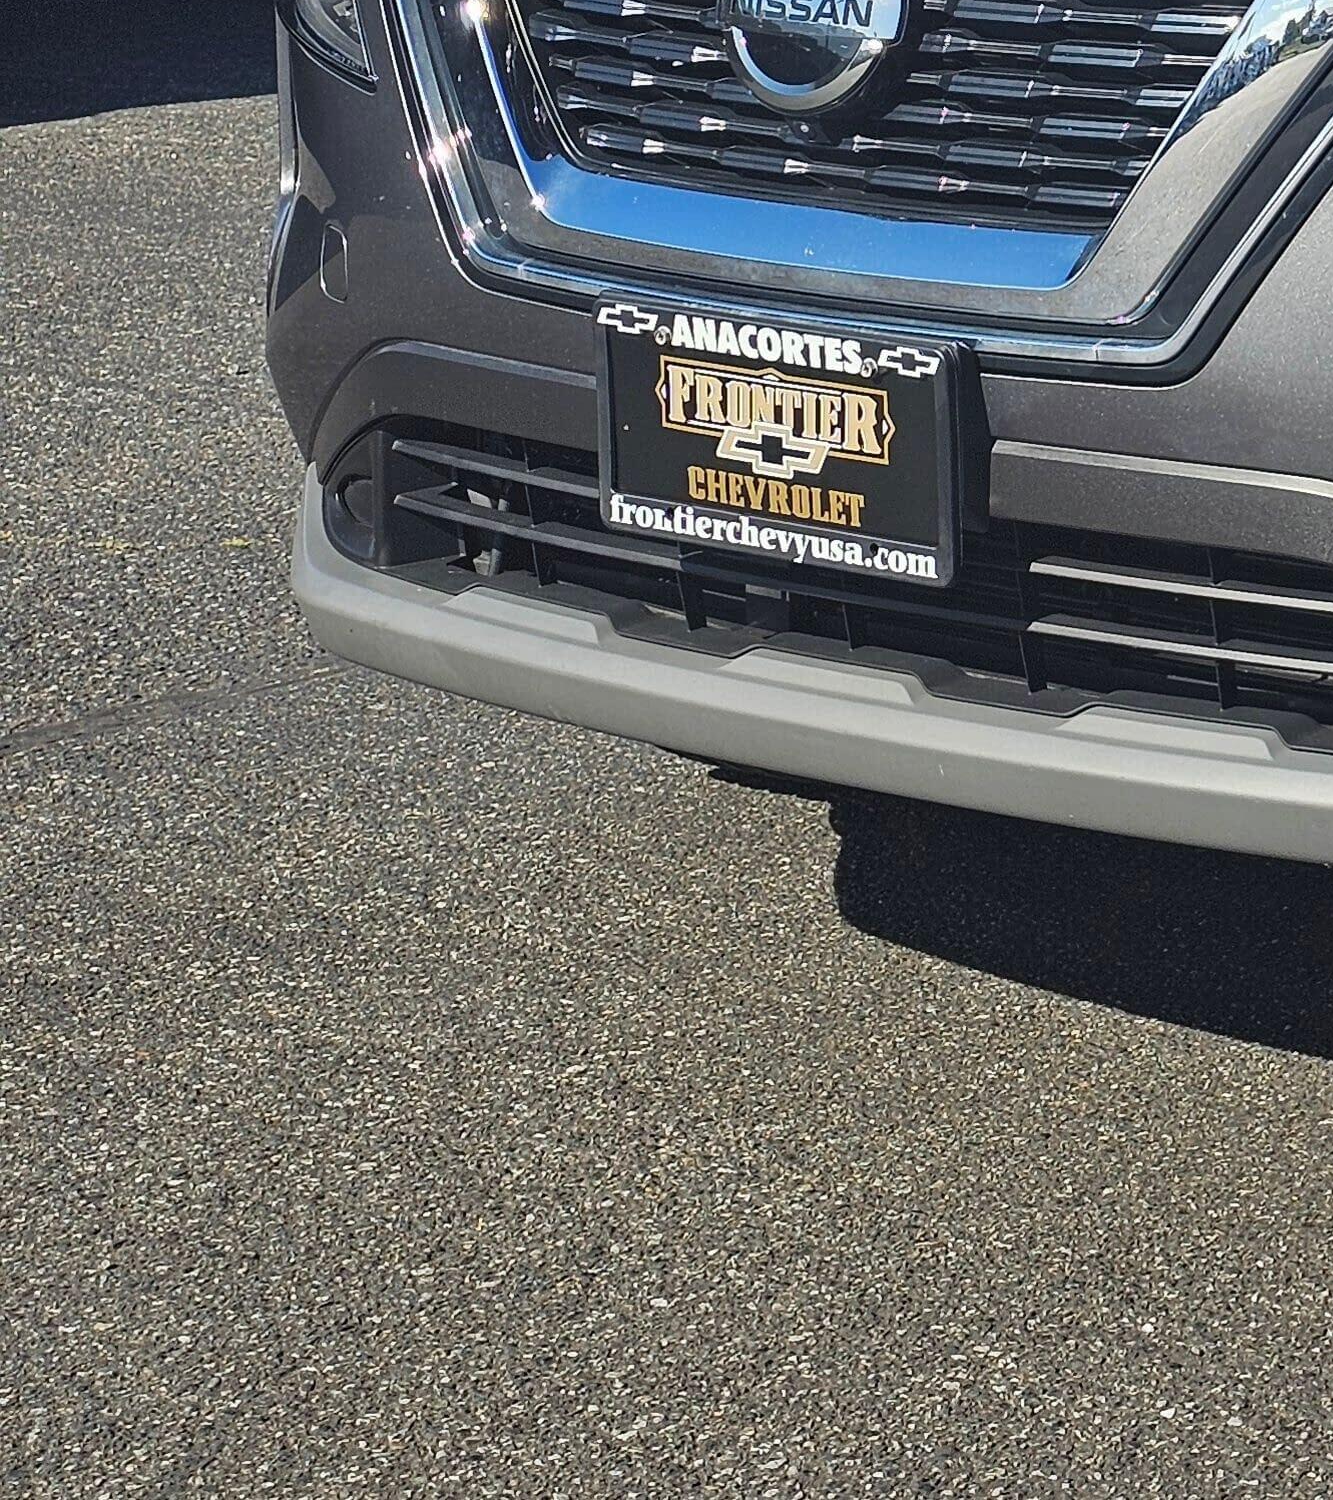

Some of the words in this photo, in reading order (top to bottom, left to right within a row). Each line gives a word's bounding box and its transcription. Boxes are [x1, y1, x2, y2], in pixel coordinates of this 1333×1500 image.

[671, 314, 864, 374] ANACORTES
[665, 363, 884, 455] FRONTIER
[686, 464, 866, 529] CHEVROLET
[609, 494, 939, 579] frontierchevyusa.com
